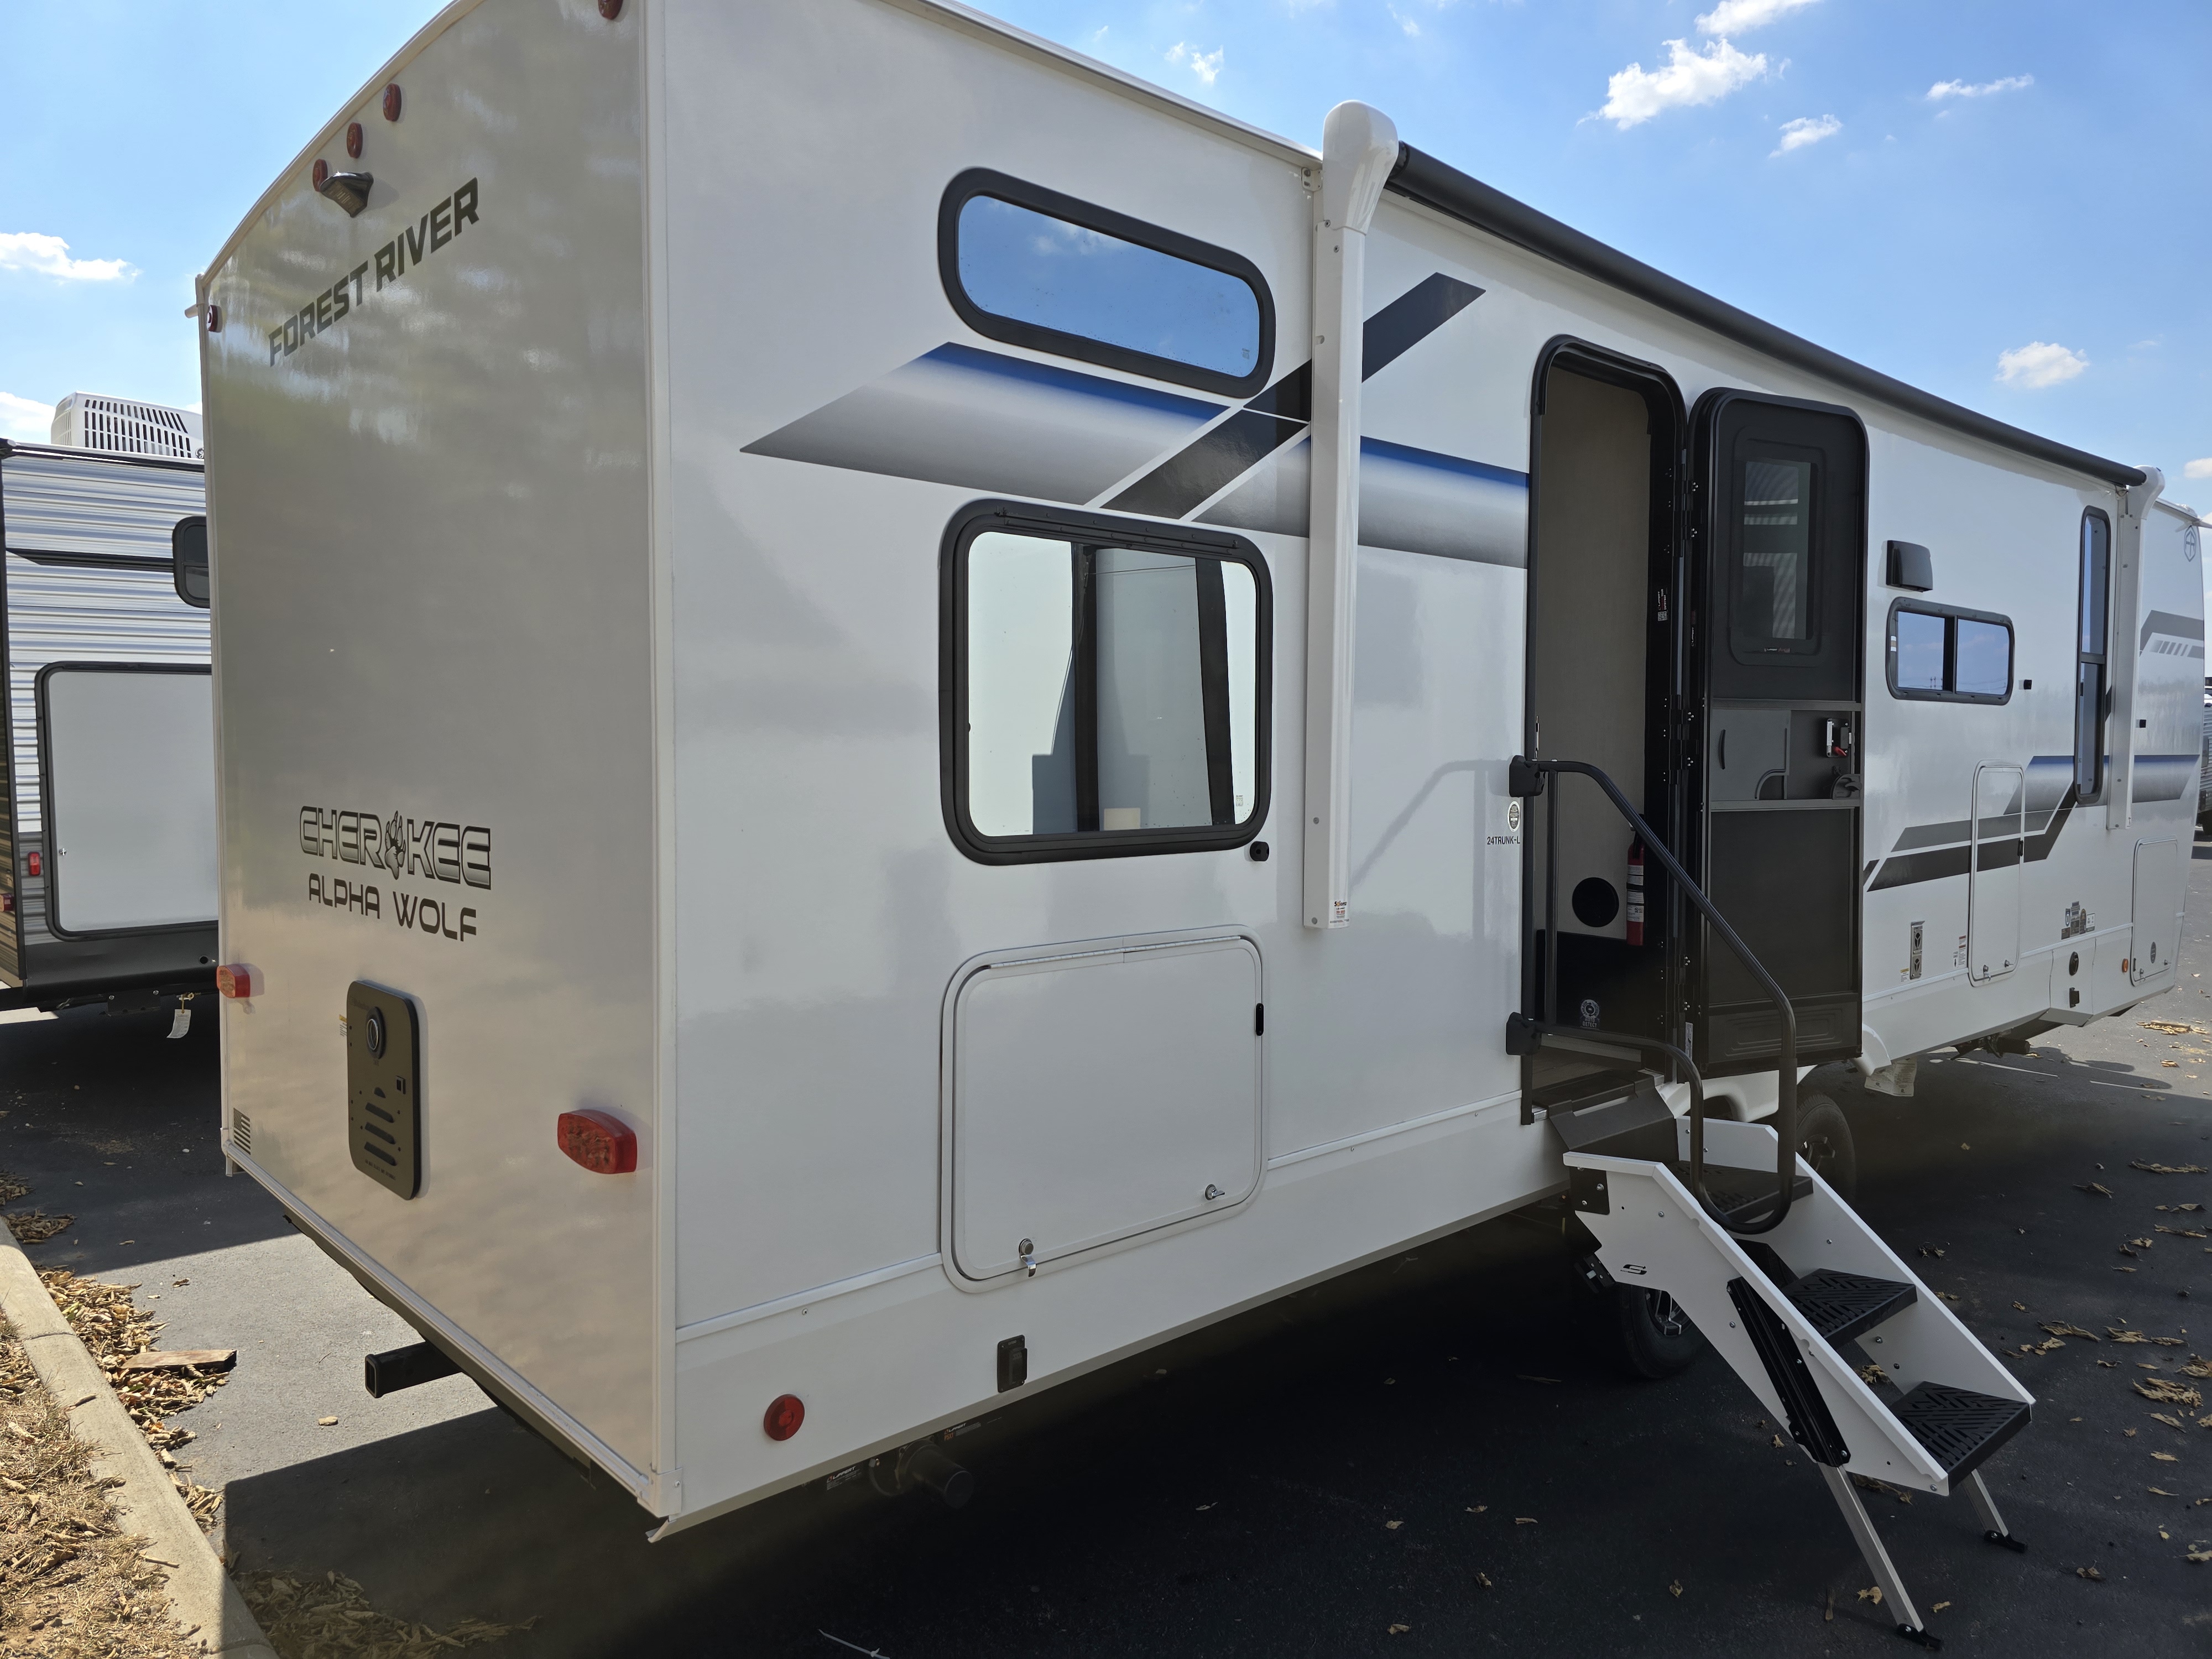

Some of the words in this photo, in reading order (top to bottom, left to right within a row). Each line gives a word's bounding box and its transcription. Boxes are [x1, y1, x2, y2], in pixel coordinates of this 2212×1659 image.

[268, 260, 368, 368] FOREST
[374, 177, 479, 293] RIVER
[1486, 836, 1521, 845] 24TRUNK-L
[309, 873, 380, 920] ALPHA
[393, 891, 477, 942] WOLF
